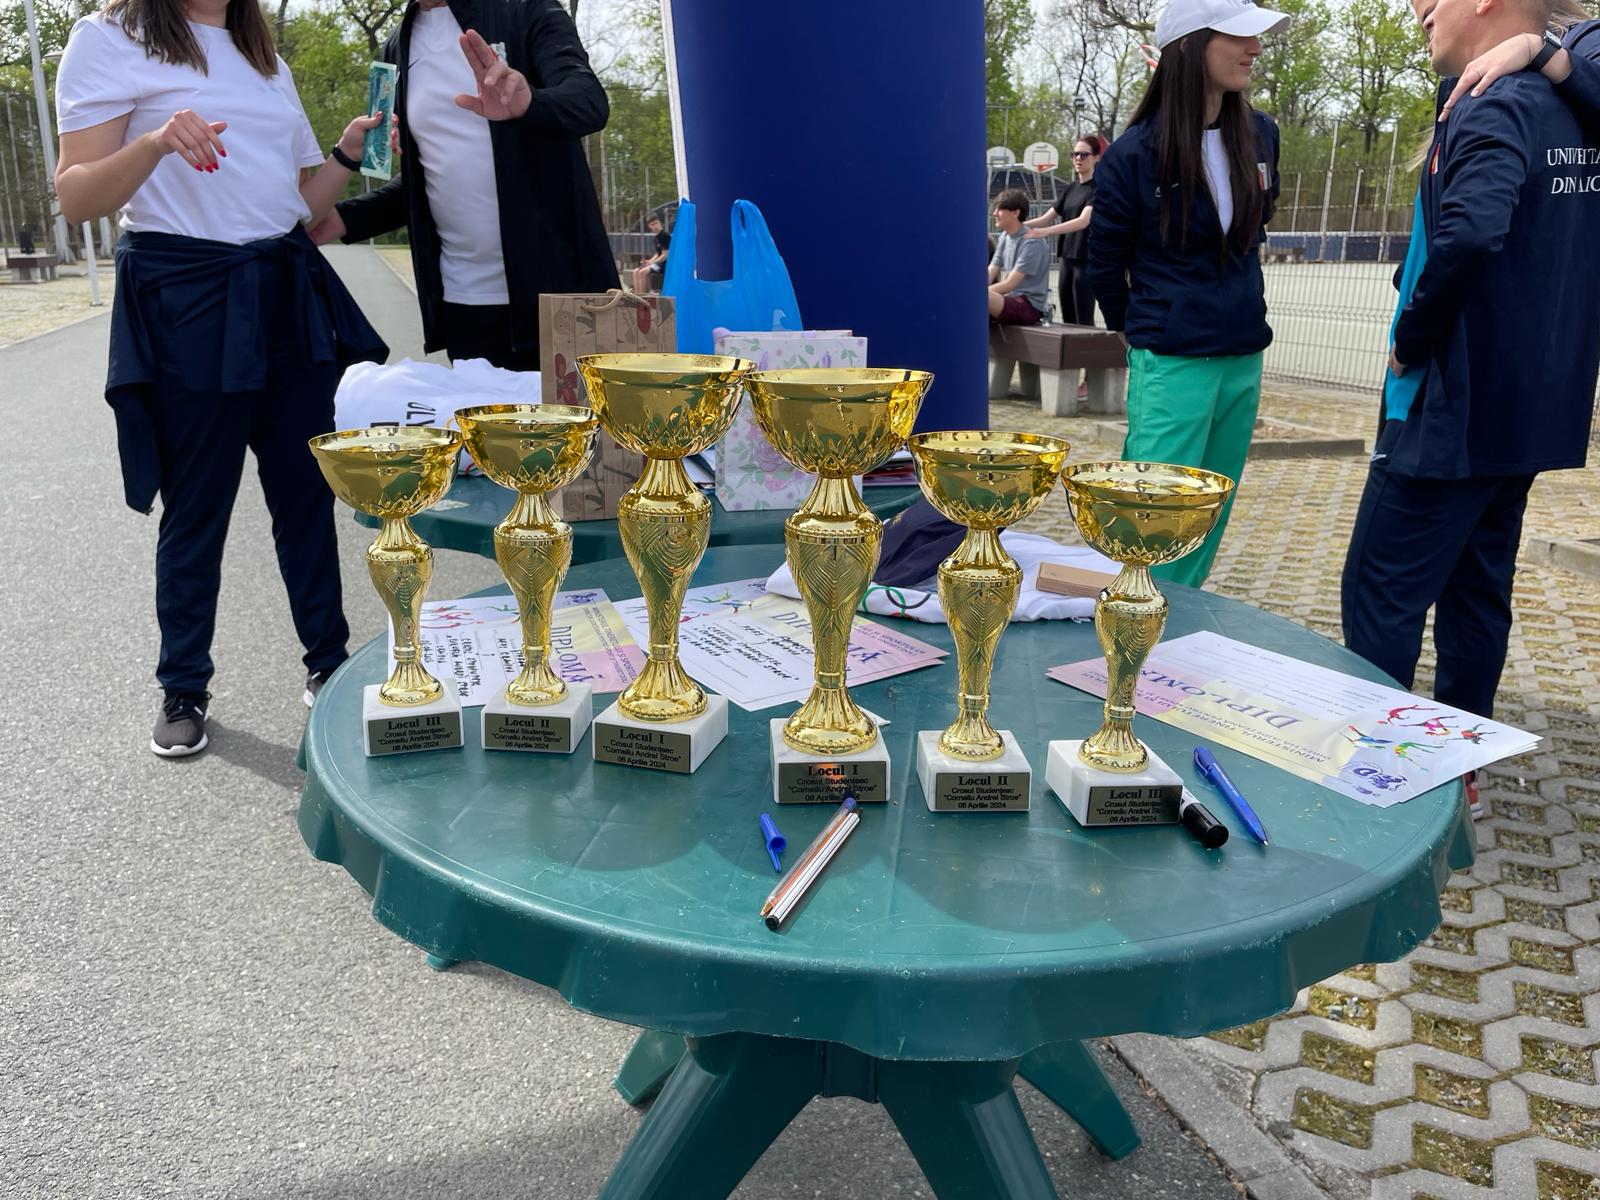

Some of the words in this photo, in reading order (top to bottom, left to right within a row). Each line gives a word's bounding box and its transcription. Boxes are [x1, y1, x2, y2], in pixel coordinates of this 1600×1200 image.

[388, 718, 420, 730] Locul
[426, 716, 441, 726] III
[505, 717, 534, 727] Locul
[540, 719, 550, 728] II
[384, 730, 406, 738] Crosul
[620, 728, 652, 742] Locul
[660, 734, 664, 744] I
[610, 740, 633, 749] Crosul
[649, 760, 666, 768] 2024
[808, 764, 845, 776] Locul
[853, 764, 858, 774] I
[958, 776, 990, 786] Locul
[998, 776, 1008, 786] II
[1110, 790, 1142, 800] Locul
